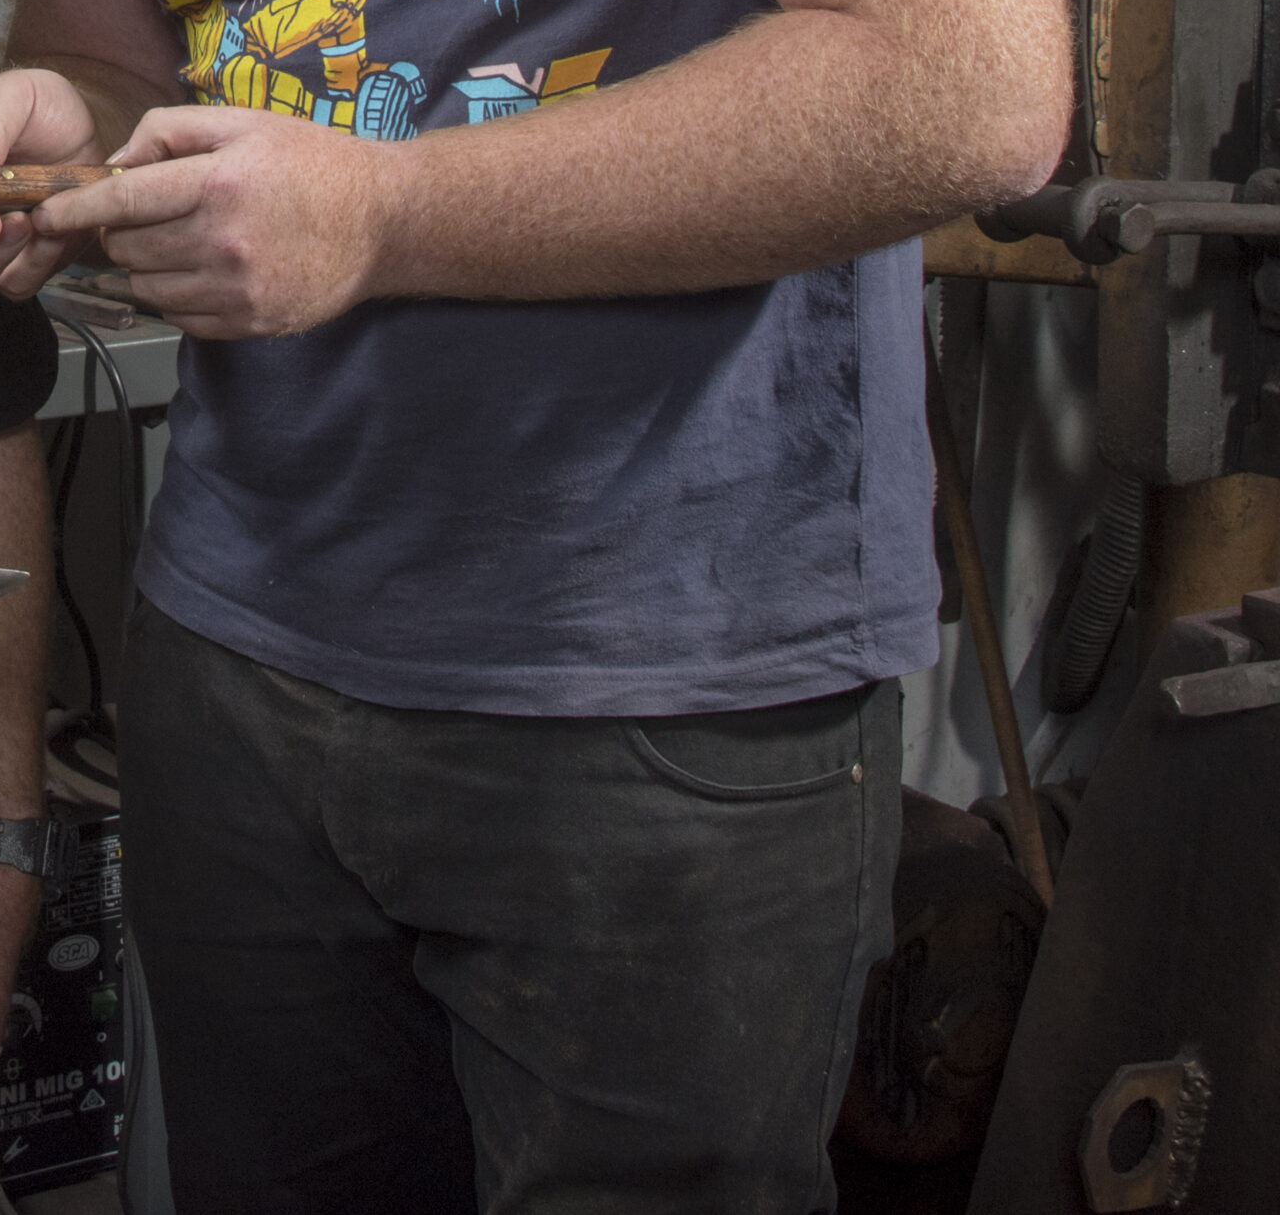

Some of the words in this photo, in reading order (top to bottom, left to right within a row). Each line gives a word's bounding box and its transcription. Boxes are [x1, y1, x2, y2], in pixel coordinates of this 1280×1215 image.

[57, 941, 91, 964] SCA
[35, 1070, 84, 1099] MIG
[91, 1060, 125, 1083] 10
